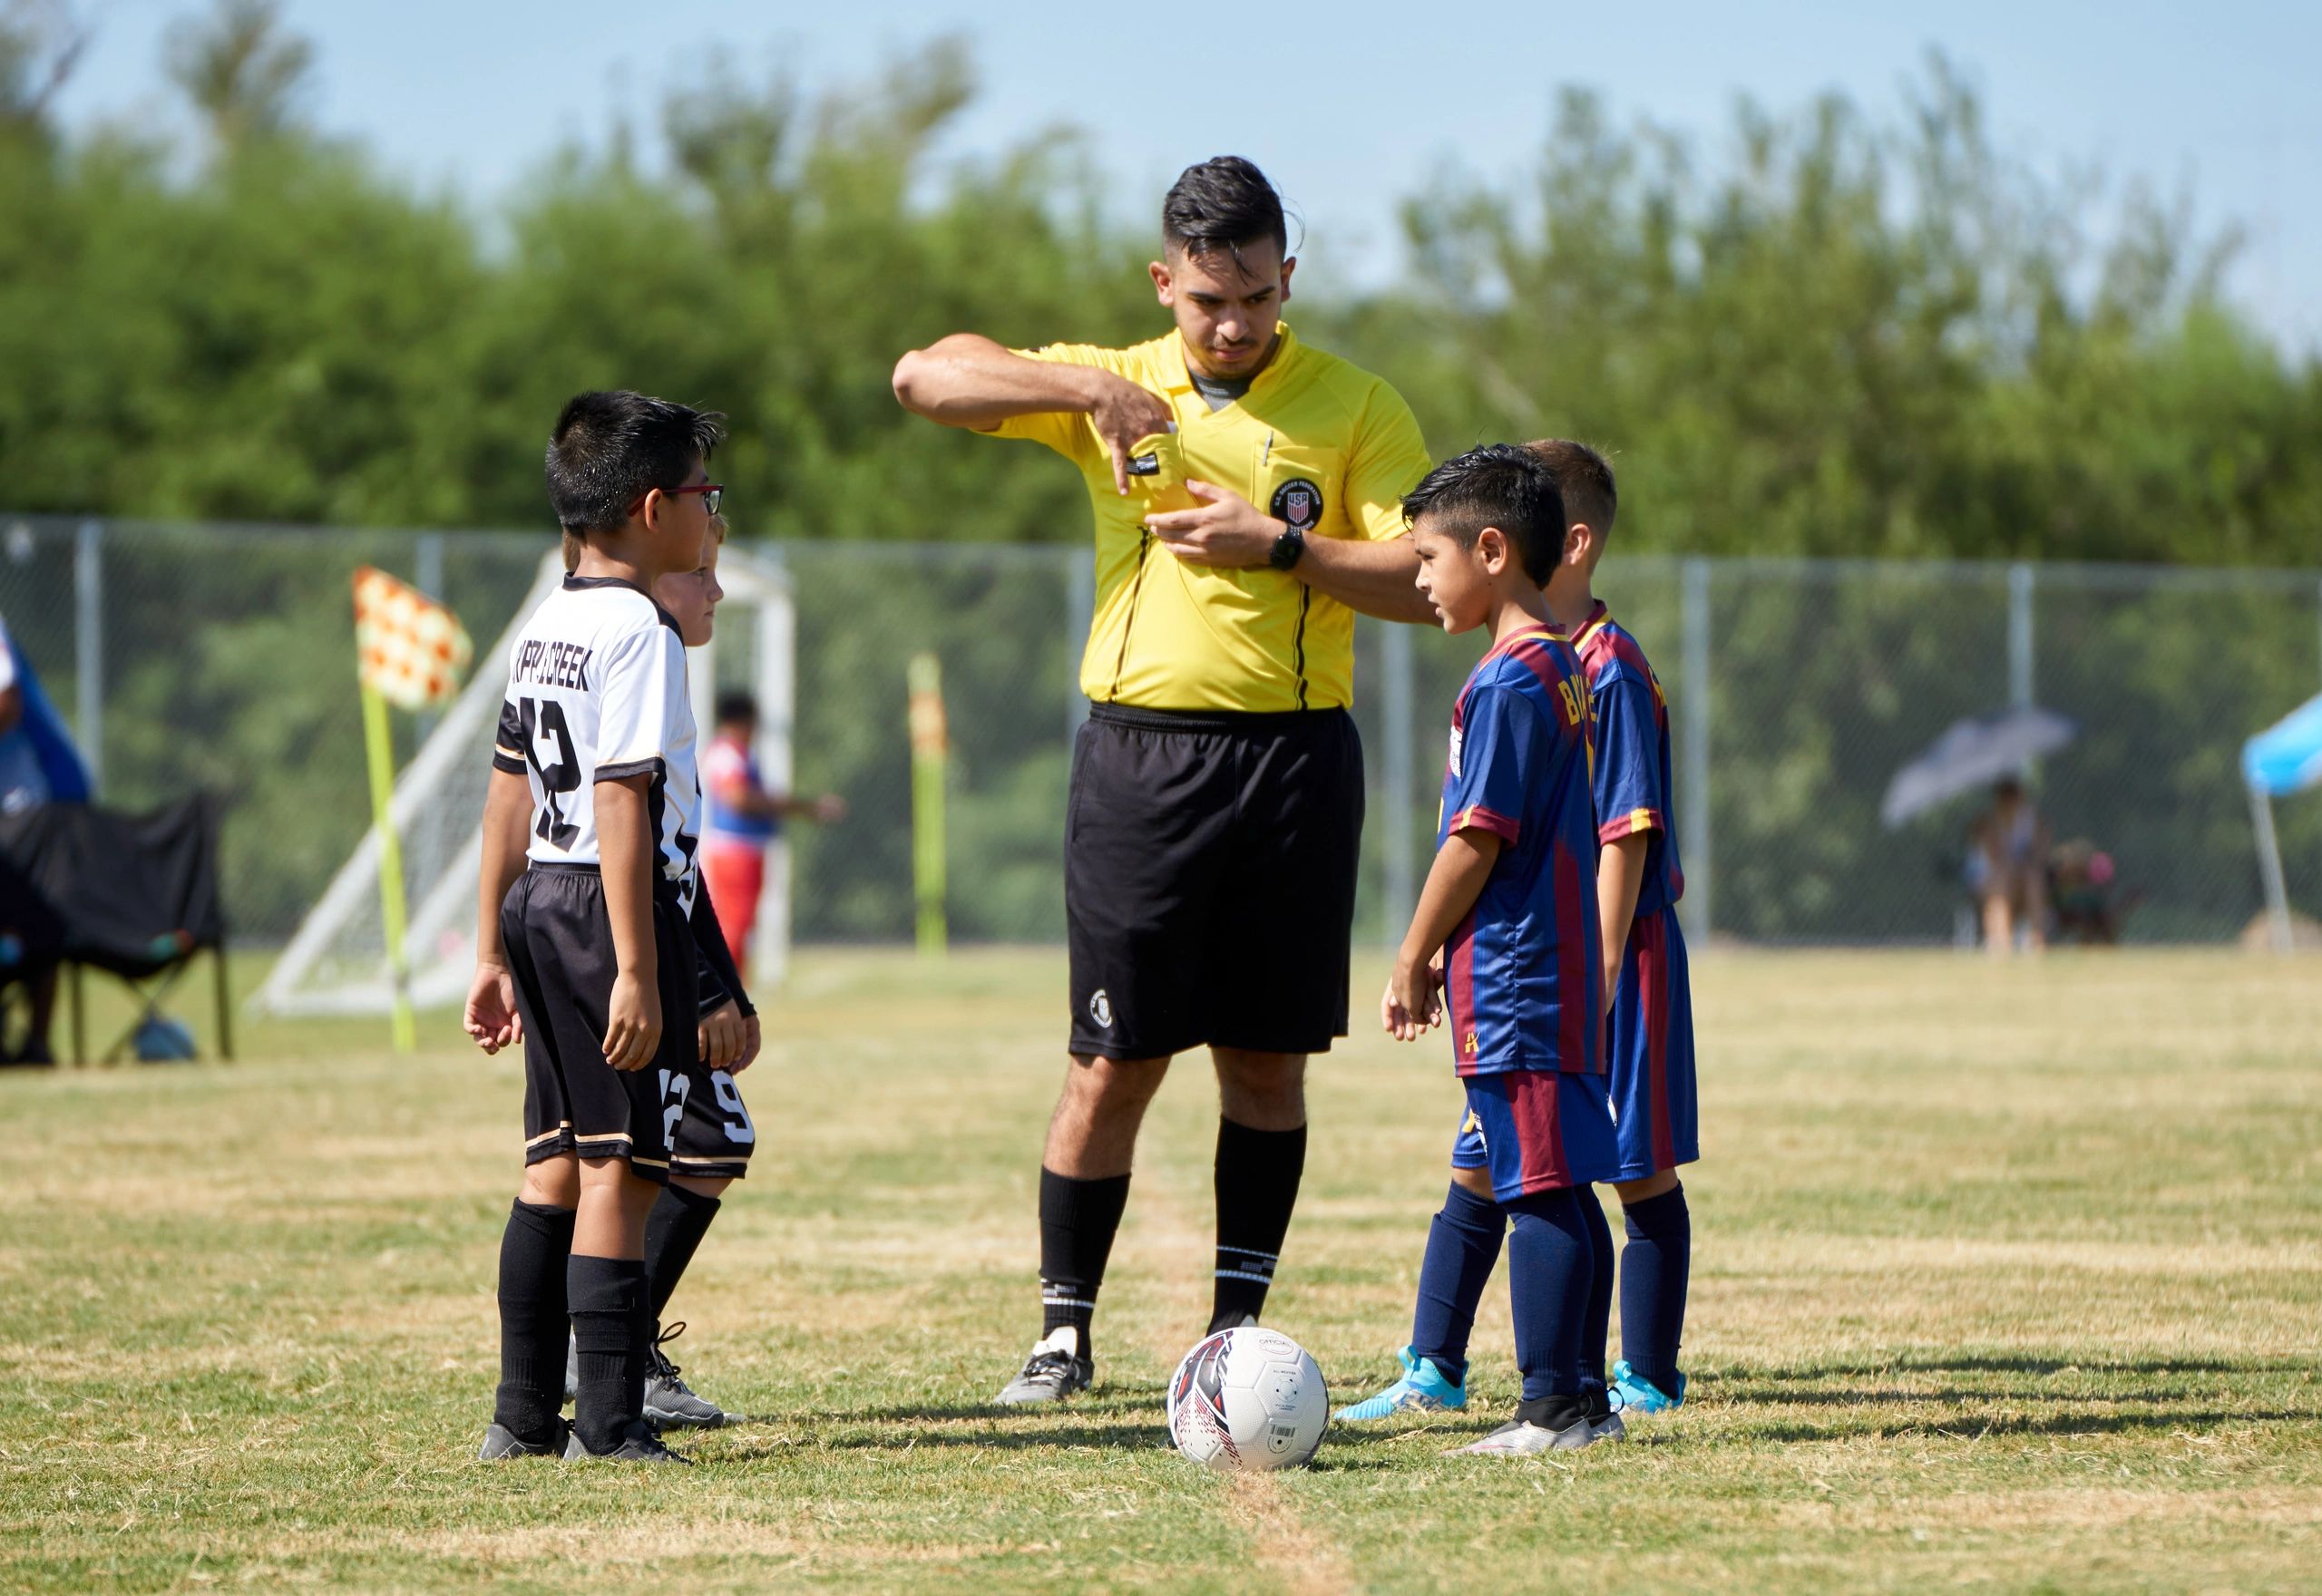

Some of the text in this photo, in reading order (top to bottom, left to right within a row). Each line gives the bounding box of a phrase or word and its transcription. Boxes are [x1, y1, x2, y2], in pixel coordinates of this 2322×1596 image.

[1279, 482, 1298, 495] SOCCER
[1288, 493, 1308, 506] USA
[519, 696, 581, 853] 12
[710, 1070, 756, 1143] 9
